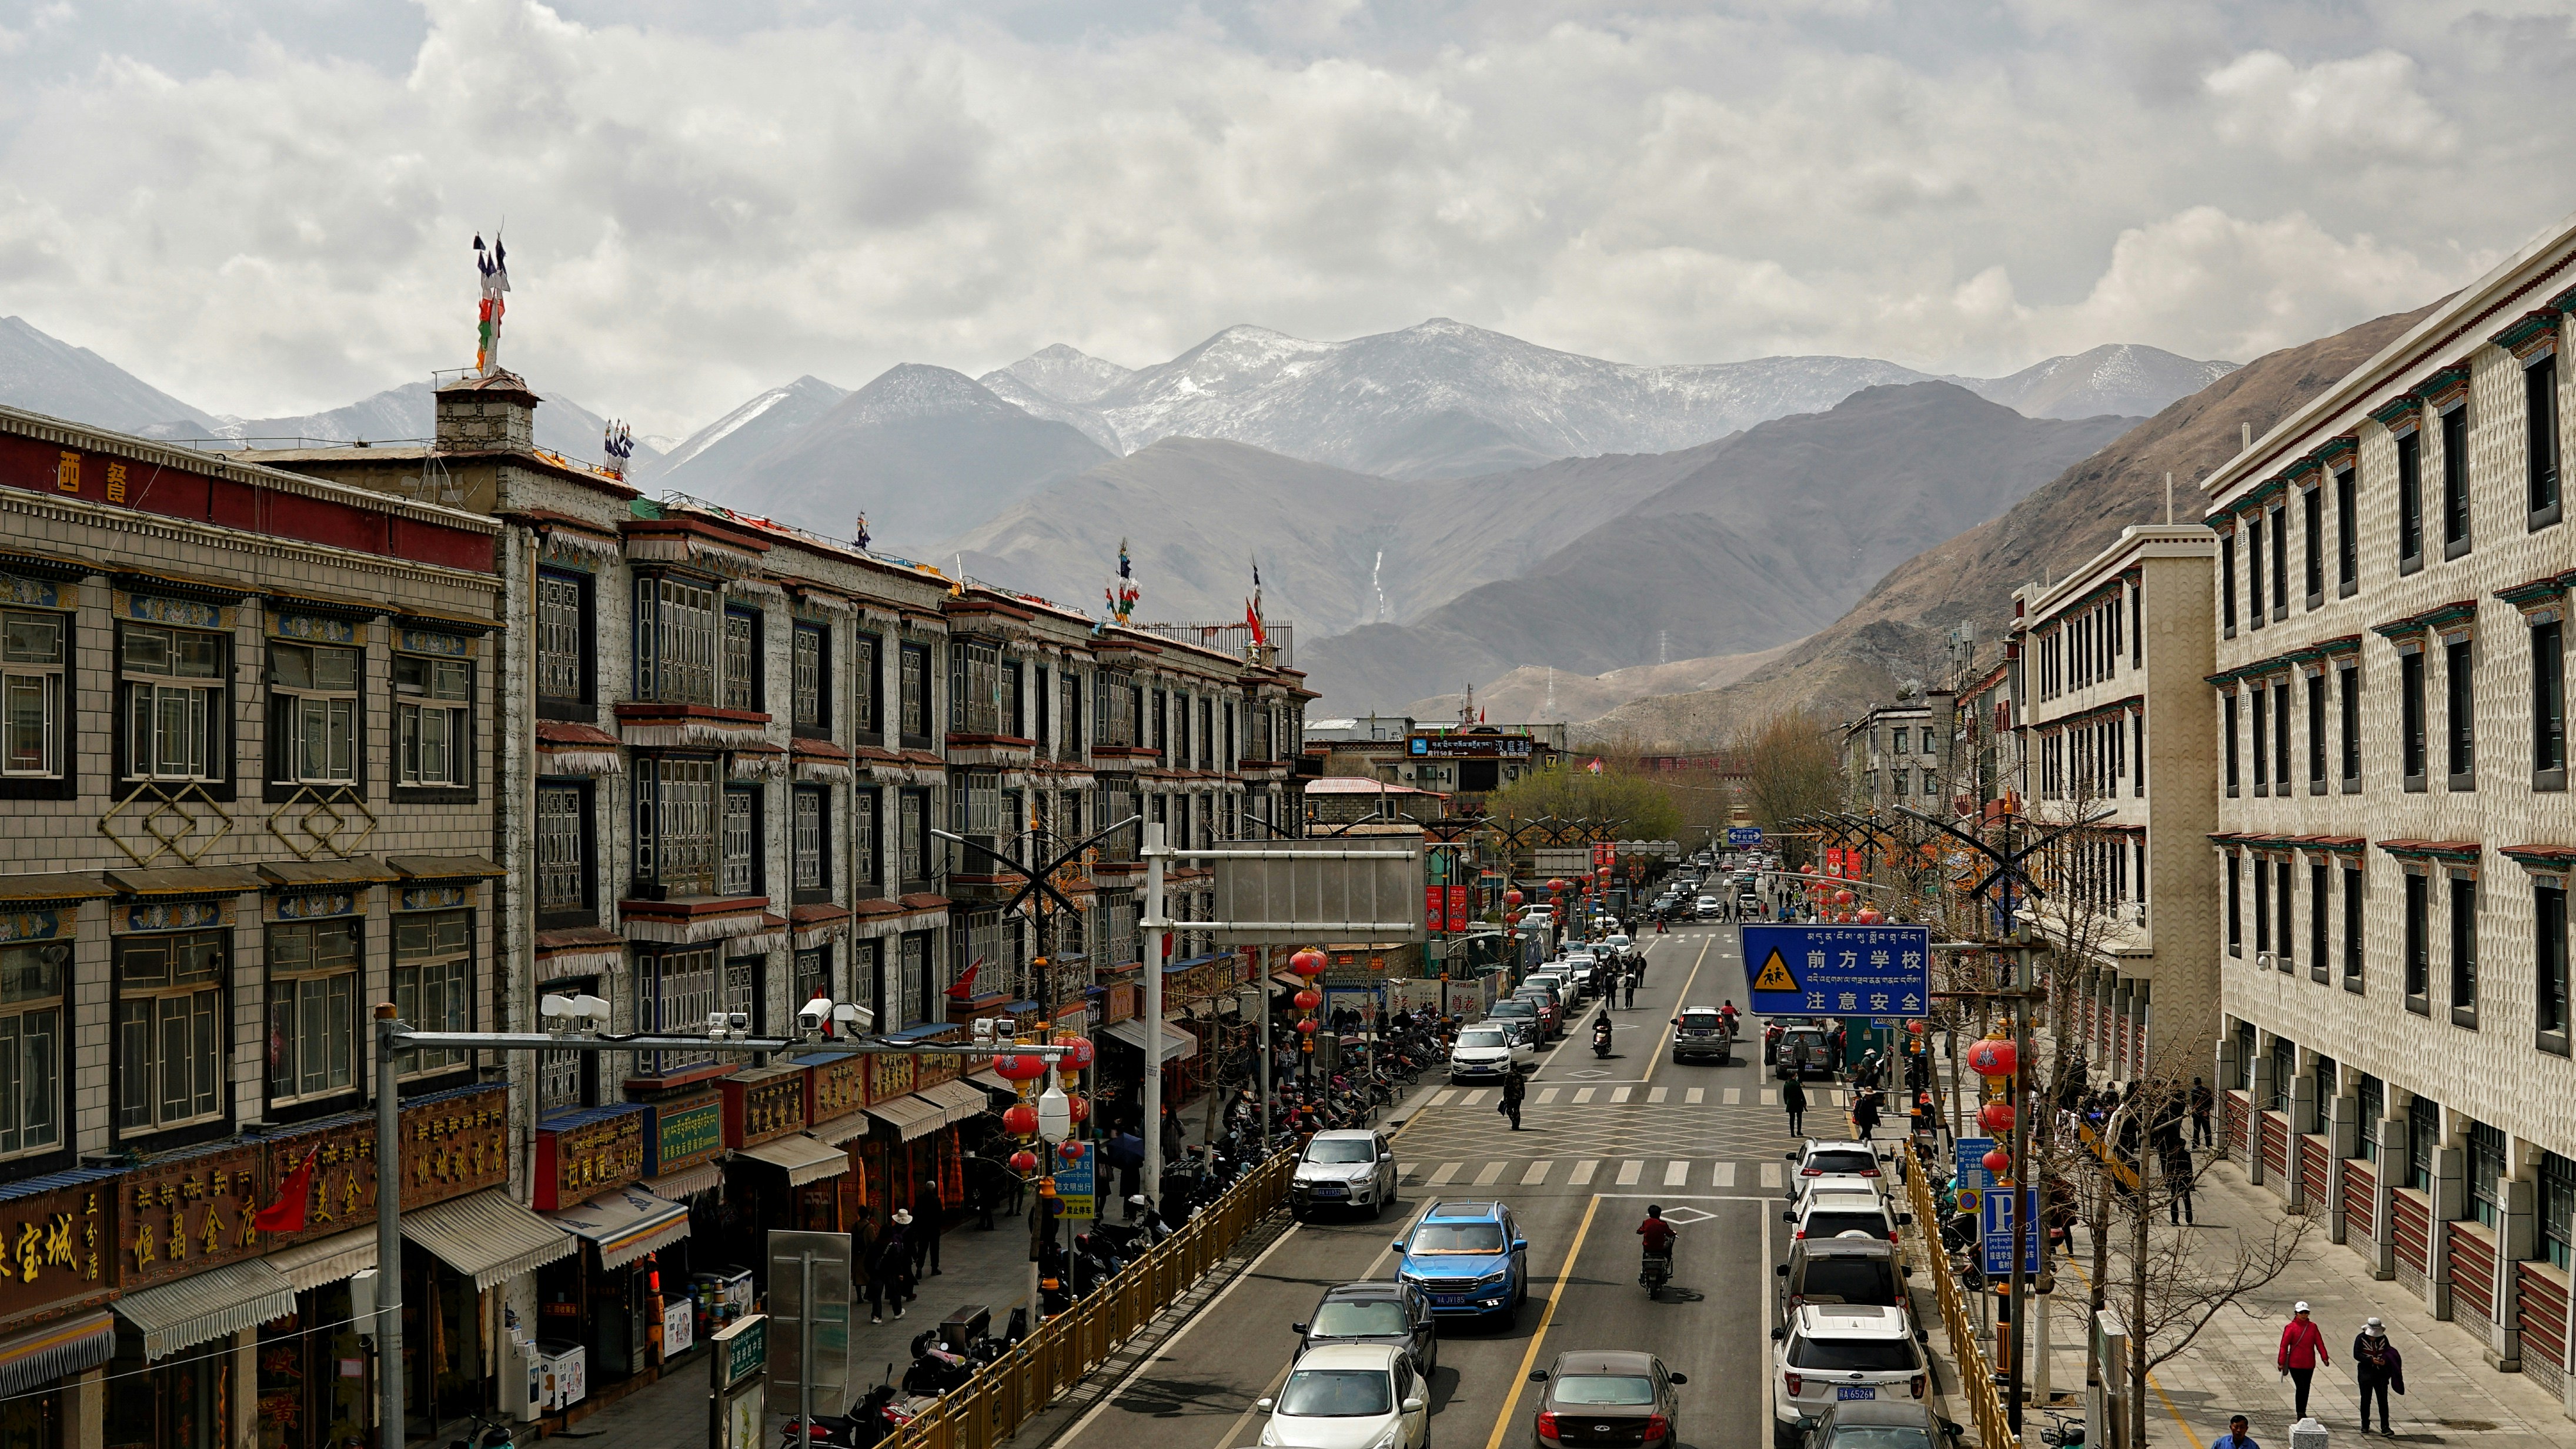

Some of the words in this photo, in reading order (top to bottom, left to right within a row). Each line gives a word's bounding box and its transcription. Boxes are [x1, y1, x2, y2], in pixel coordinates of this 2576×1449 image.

[60, 451, 126, 504] 西餐
[1495, 739, 1532, 752] 汉庭酒店
[1548, 757, 1555, 765] 7
[1806, 949, 1922, 969] 前方学校
[1452, 995, 1475, 1012] 尊老
[1806, 992, 1921, 1011] 注意安全
[1075, 1101, 1088, 1117] 扎
[1067, 1206, 1091, 1215] 禁止停车
[1991, 1194, 2014, 1232] P
[86, 1193, 98, 1281] 三分店
[134, 1194, 257, 1273] 恒晶金店
